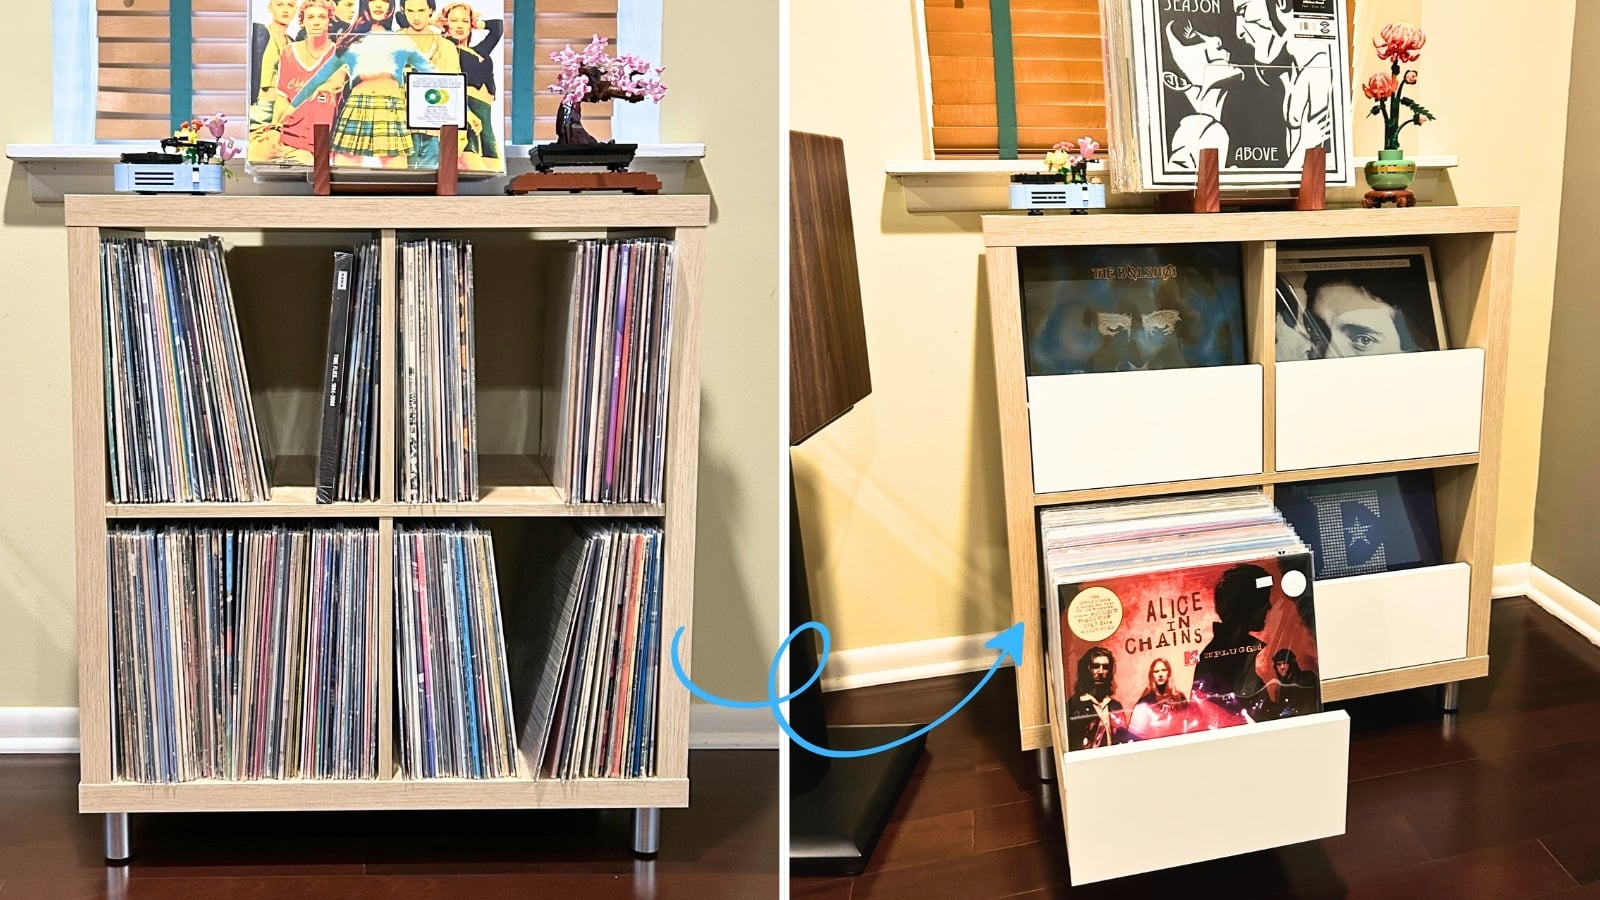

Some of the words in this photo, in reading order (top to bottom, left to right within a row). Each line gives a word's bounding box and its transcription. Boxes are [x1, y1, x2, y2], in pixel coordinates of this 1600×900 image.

[1164, 0, 1220, 14] SEASON
[1235, 146, 1280, 161] ABOVE
[1091, 266, 1115, 280] THE
[1307, 490, 1388, 579] E
[1147, 591, 1203, 623] ALICE
[1167, 615, 1191, 632] IN
[1125, 628, 1203, 655] CHAINS
